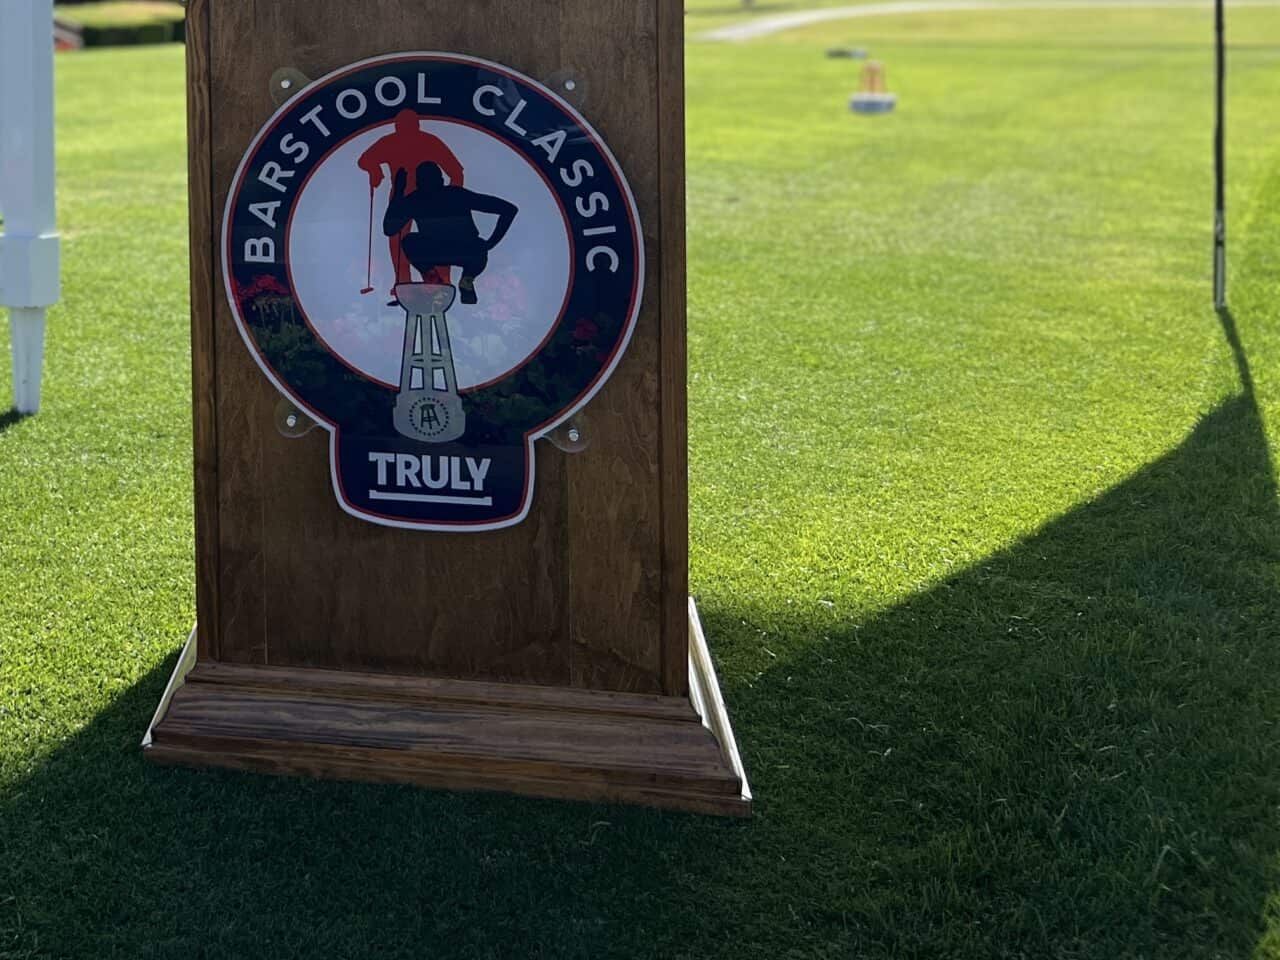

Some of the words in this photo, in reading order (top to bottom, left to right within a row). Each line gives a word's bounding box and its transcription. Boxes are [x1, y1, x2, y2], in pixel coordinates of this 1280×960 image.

[244, 73, 442, 264] BARSTOOL
[472, 84, 620, 274] CLASSIC
[368, 451, 492, 492] TRULY
